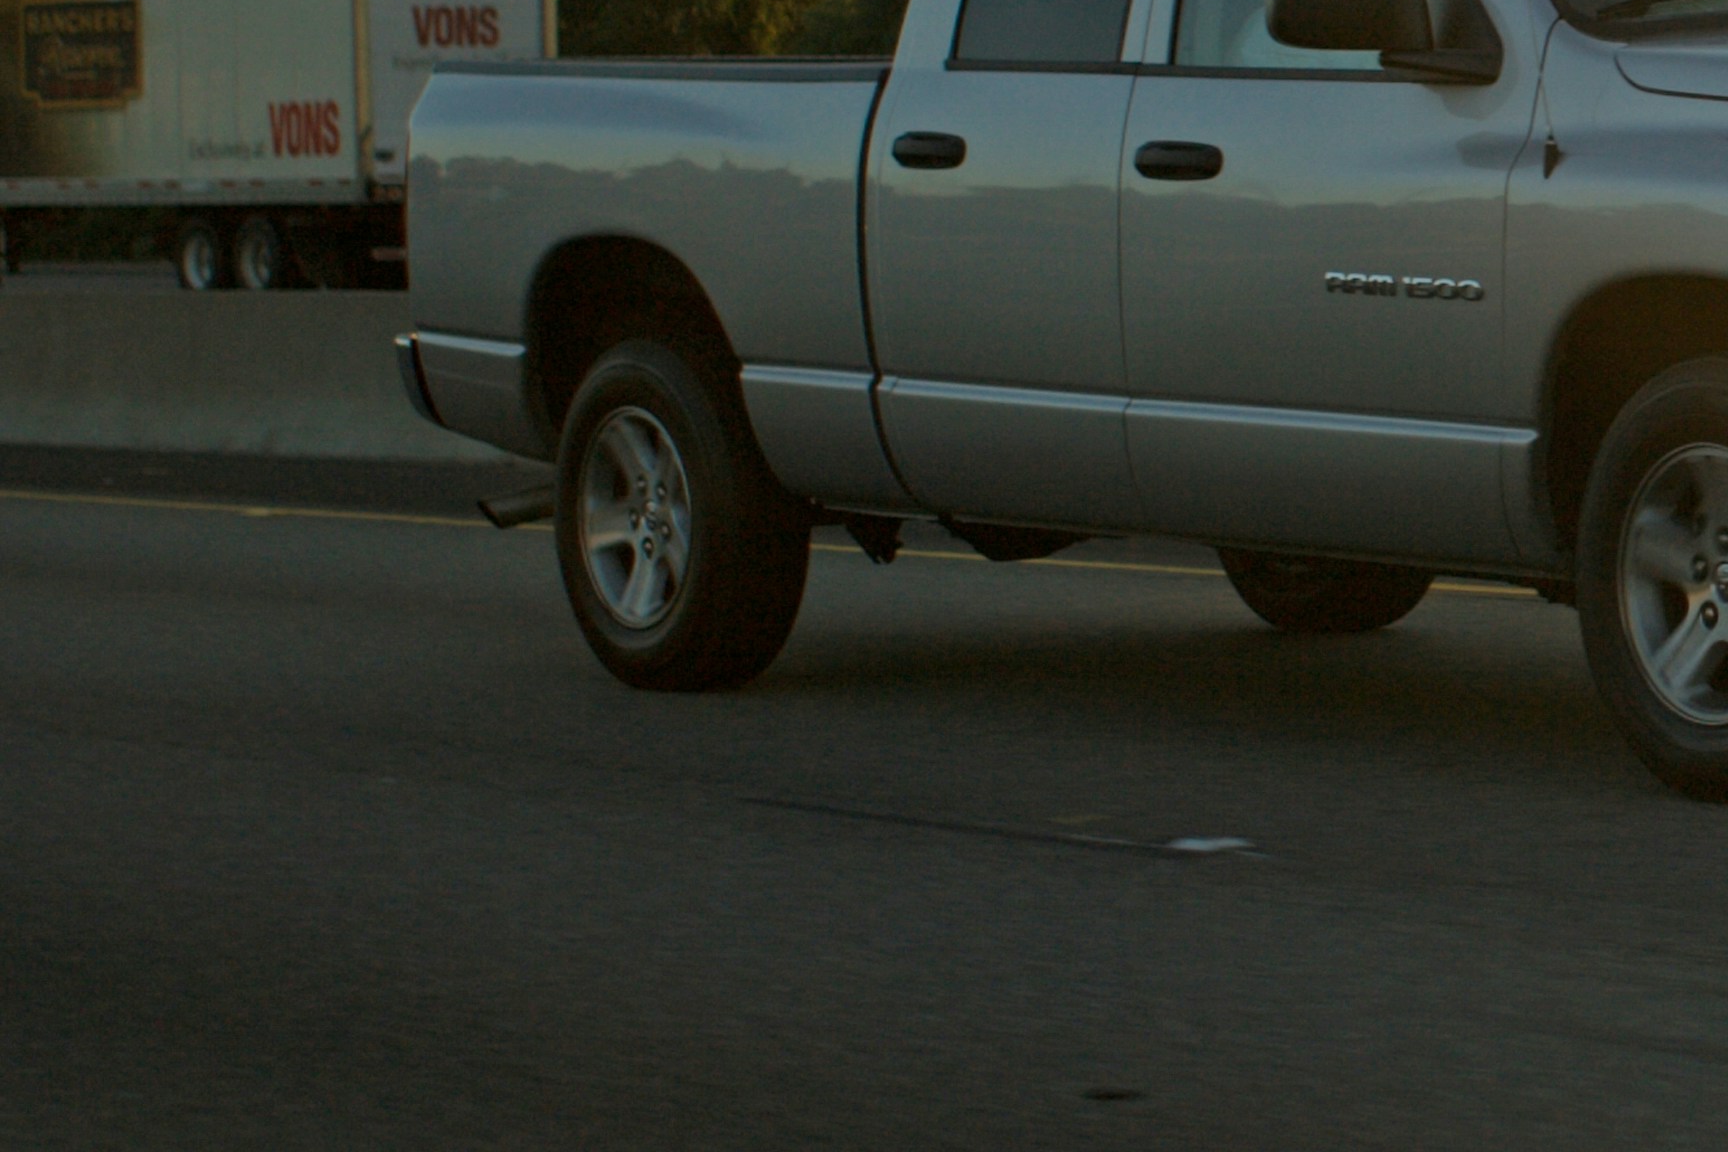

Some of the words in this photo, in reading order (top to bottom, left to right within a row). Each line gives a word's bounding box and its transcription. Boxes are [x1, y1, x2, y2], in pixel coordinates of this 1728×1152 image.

[411, 5, 499, 47] VONS
[269, 99, 341, 157] VONS
[1324, 272, 1397, 297] RAM
[1402, 276, 1485, 301] 1500
